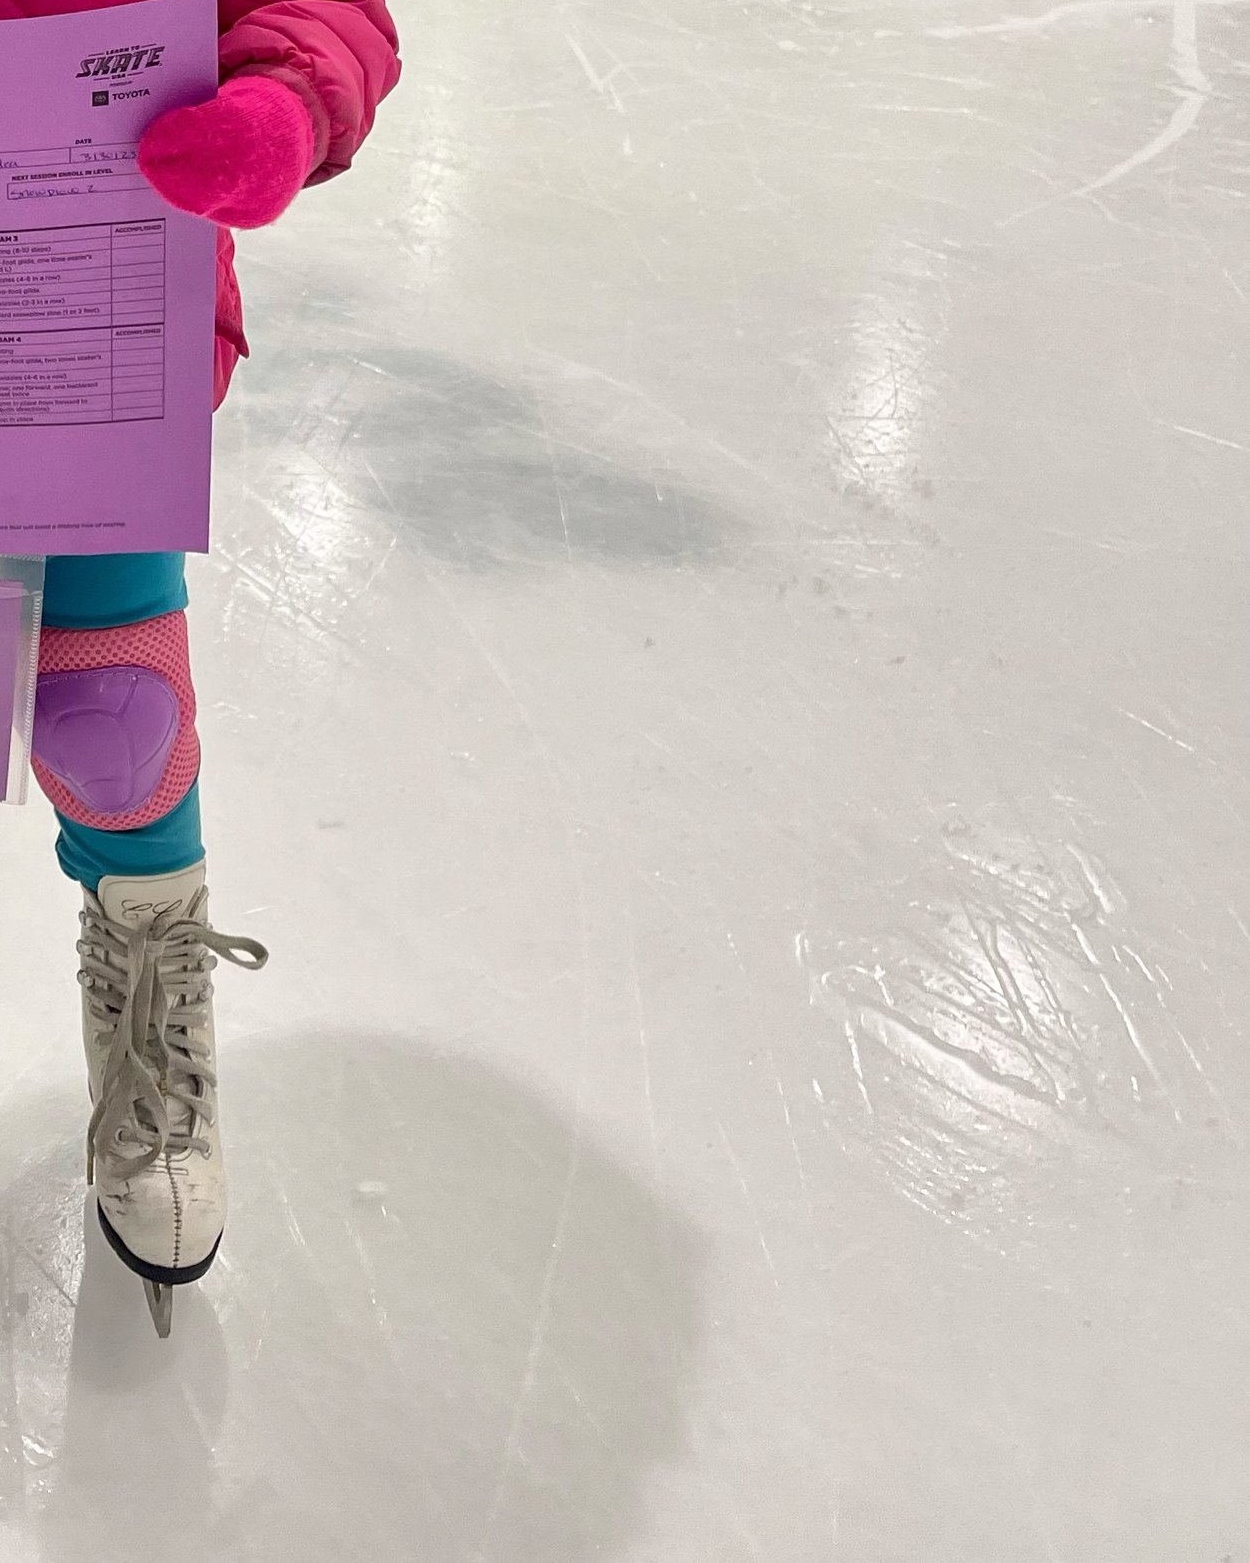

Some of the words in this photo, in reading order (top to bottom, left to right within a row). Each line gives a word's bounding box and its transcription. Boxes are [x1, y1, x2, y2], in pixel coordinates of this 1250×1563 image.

[75, 46, 165, 78] SKATE
[113, 89, 150, 100] TOYOTA
[115, 225, 162, 233] ACCOMPLISHED
